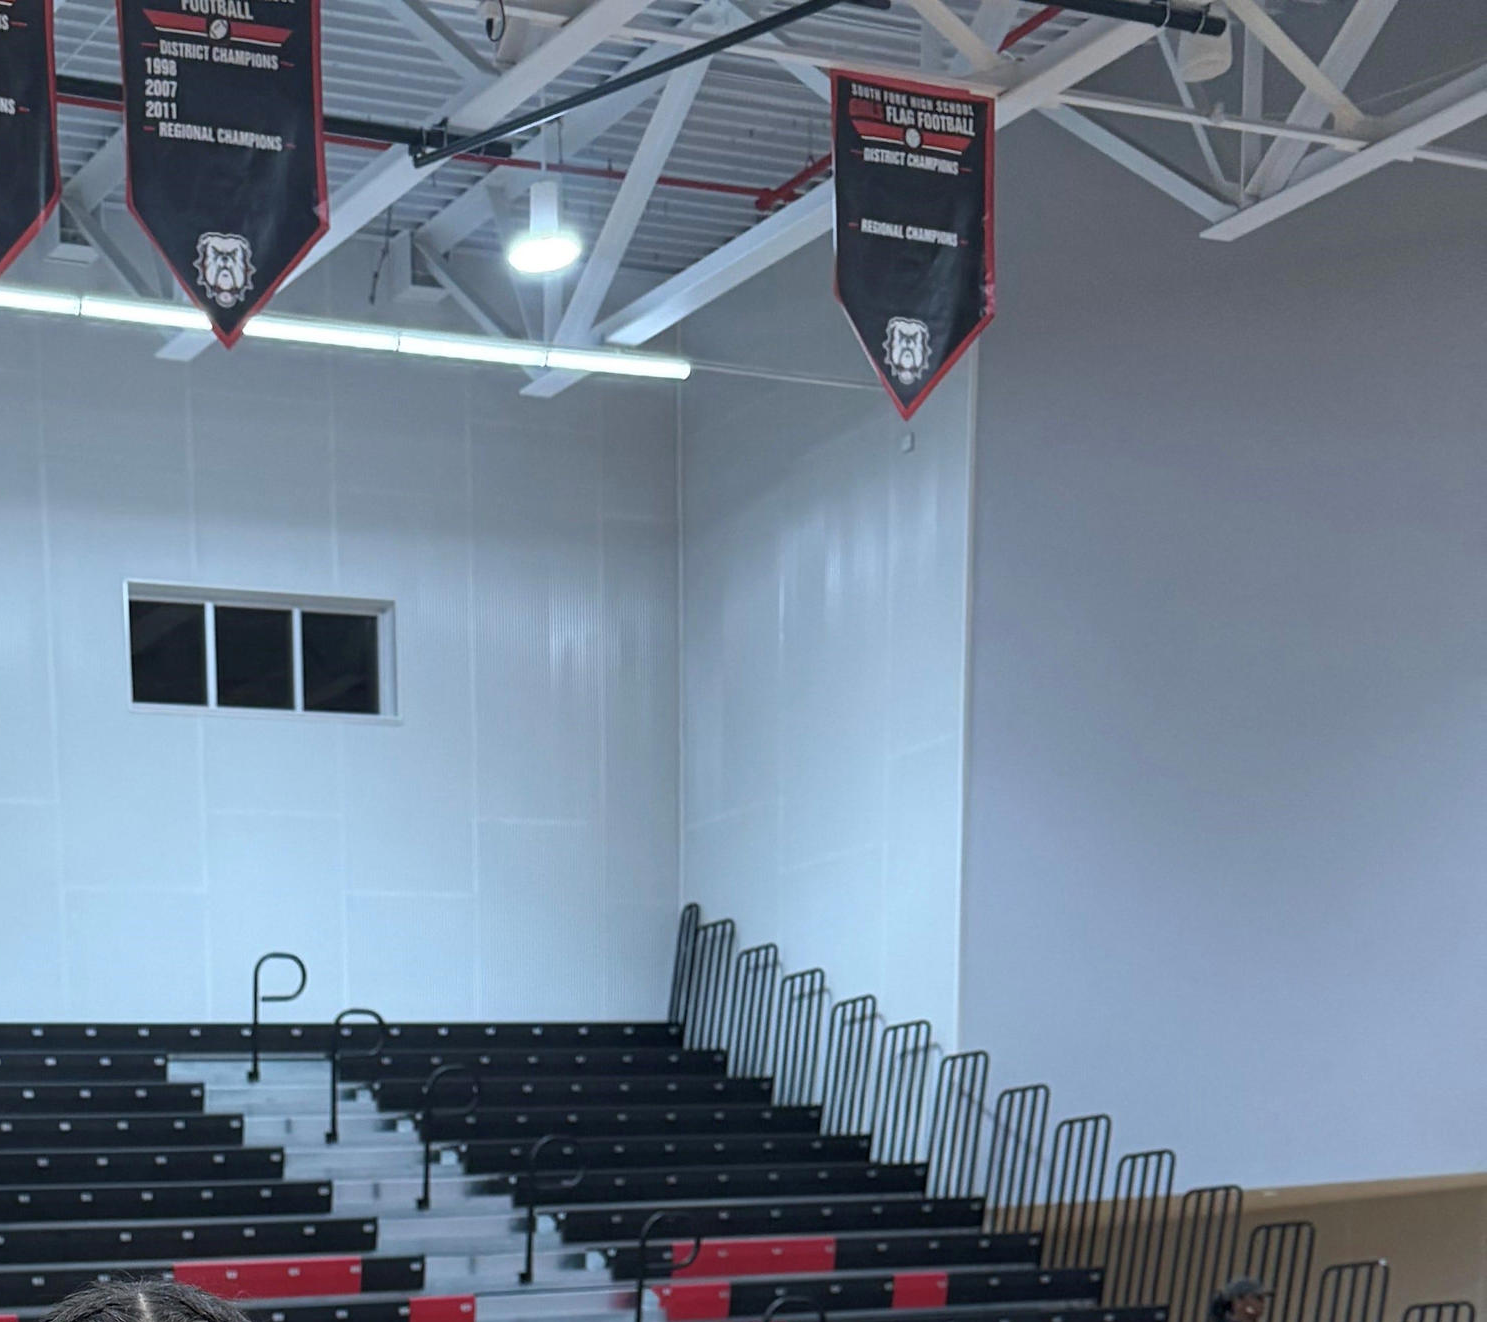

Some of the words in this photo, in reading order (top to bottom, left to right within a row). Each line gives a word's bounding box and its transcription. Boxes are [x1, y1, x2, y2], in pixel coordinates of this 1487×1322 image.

[181, 0, 254, 20] FOOTBALL
[145, 57, 177, 76] 1998
[159, 39, 210, 62] DISTRICT
[212, 46, 279, 71] CHAMPIONS
[144, 79, 177, 98] 2007
[145, 101, 177, 120] 2011
[885, 105, 915, 125] FLAG
[917, 111, 975, 137] FOOTBALL
[158, 121, 215, 143] REGIONAL
[217, 127, 283, 151] CHAMPIONS
[863, 147, 906, 166] DISTRICT
[906, 152, 959, 176] CHAMPIONS
